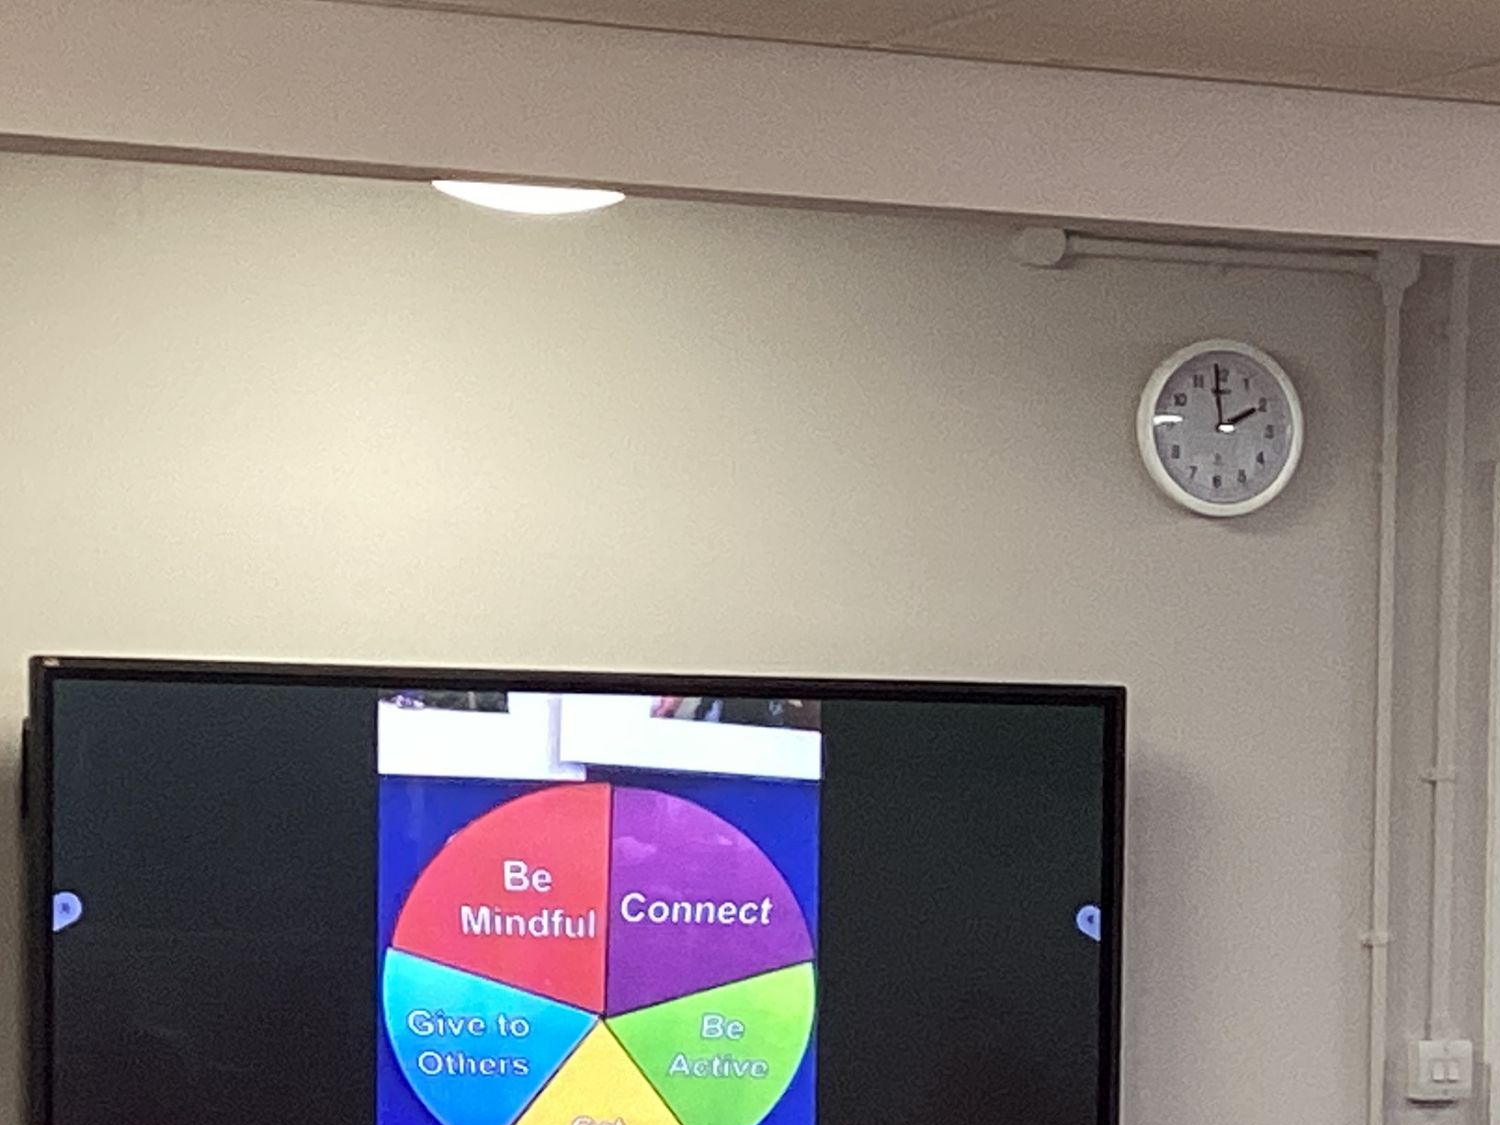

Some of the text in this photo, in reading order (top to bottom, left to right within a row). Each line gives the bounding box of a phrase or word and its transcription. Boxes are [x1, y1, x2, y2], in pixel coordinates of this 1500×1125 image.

[503, 861, 552, 892] Be
[460, 905, 597, 939] Mindful
[619, 893, 773, 925] Connect
[407, 1009, 530, 1037] Give to
[700, 1014, 745, 1041] Be
[417, 1051, 530, 1077] Others
[668, 1055, 769, 1079] Active
